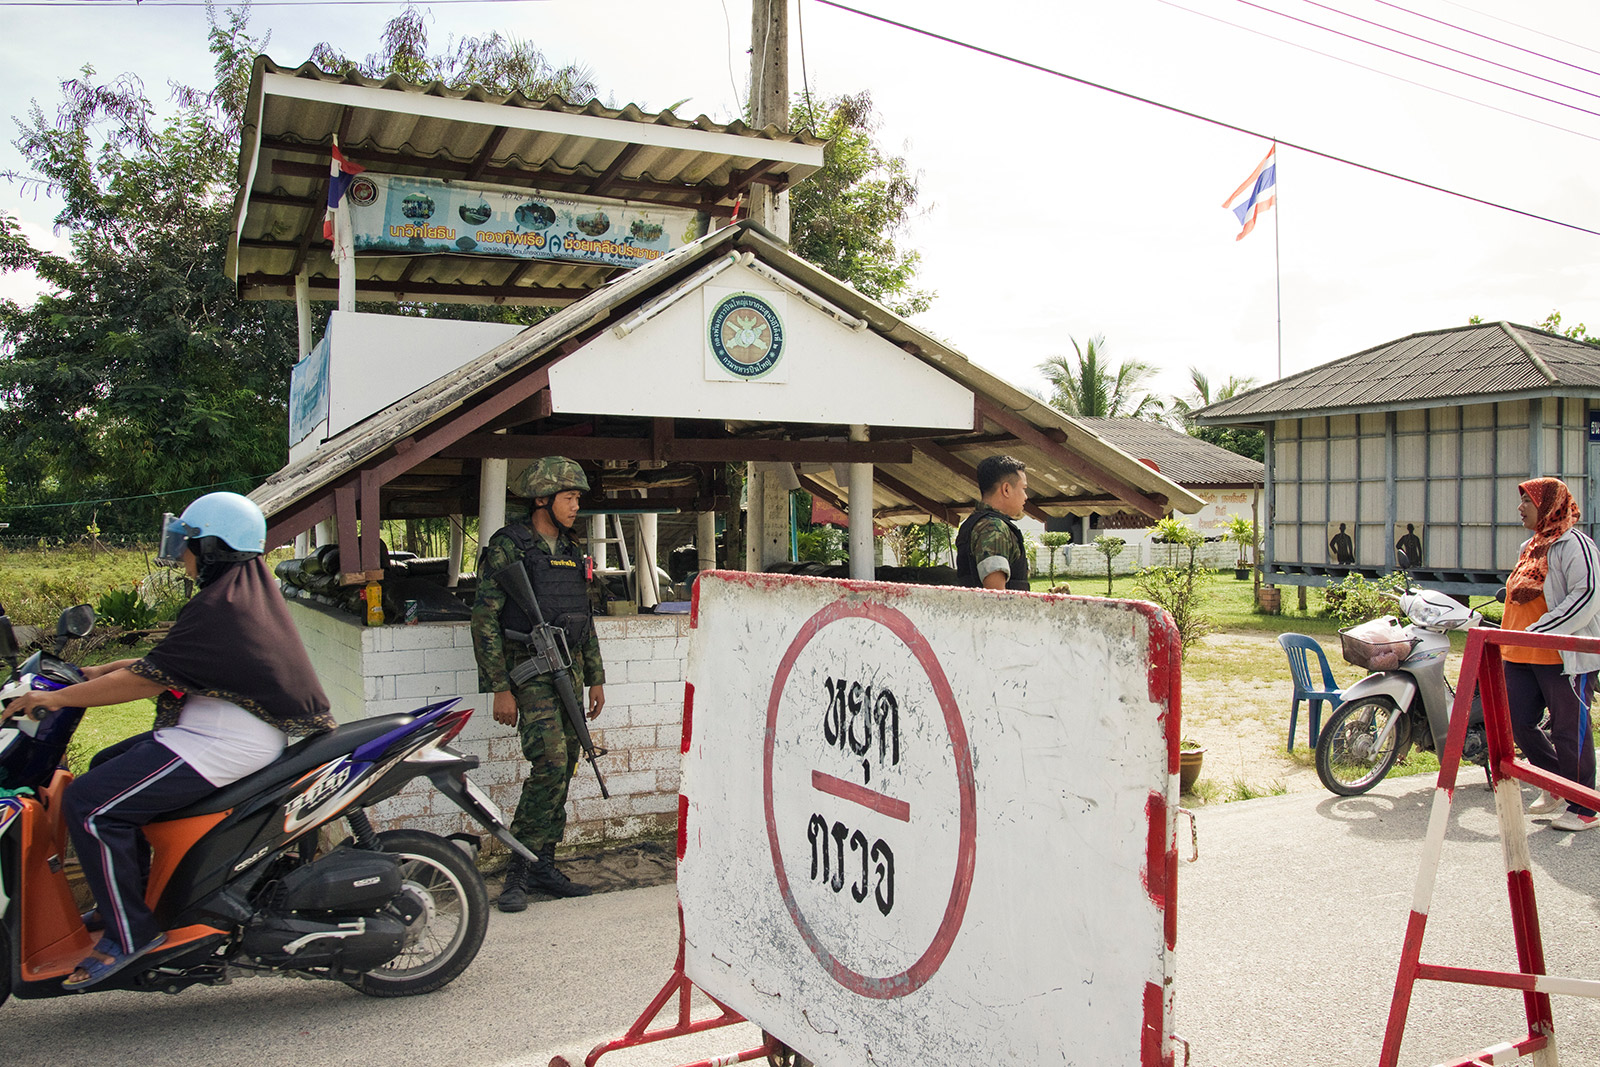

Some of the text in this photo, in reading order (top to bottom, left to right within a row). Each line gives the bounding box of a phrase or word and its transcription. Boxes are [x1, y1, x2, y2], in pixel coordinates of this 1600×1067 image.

[389, 222, 456, 241] นาวิกโยธิน
[476, 229, 545, 247] กองทัพเรือ
[722, 356, 773, 375] กรมทหารปืนใหญ่
[823, 675, 900, 785] หยุด
[807, 812, 895, 917] ตรวจ
